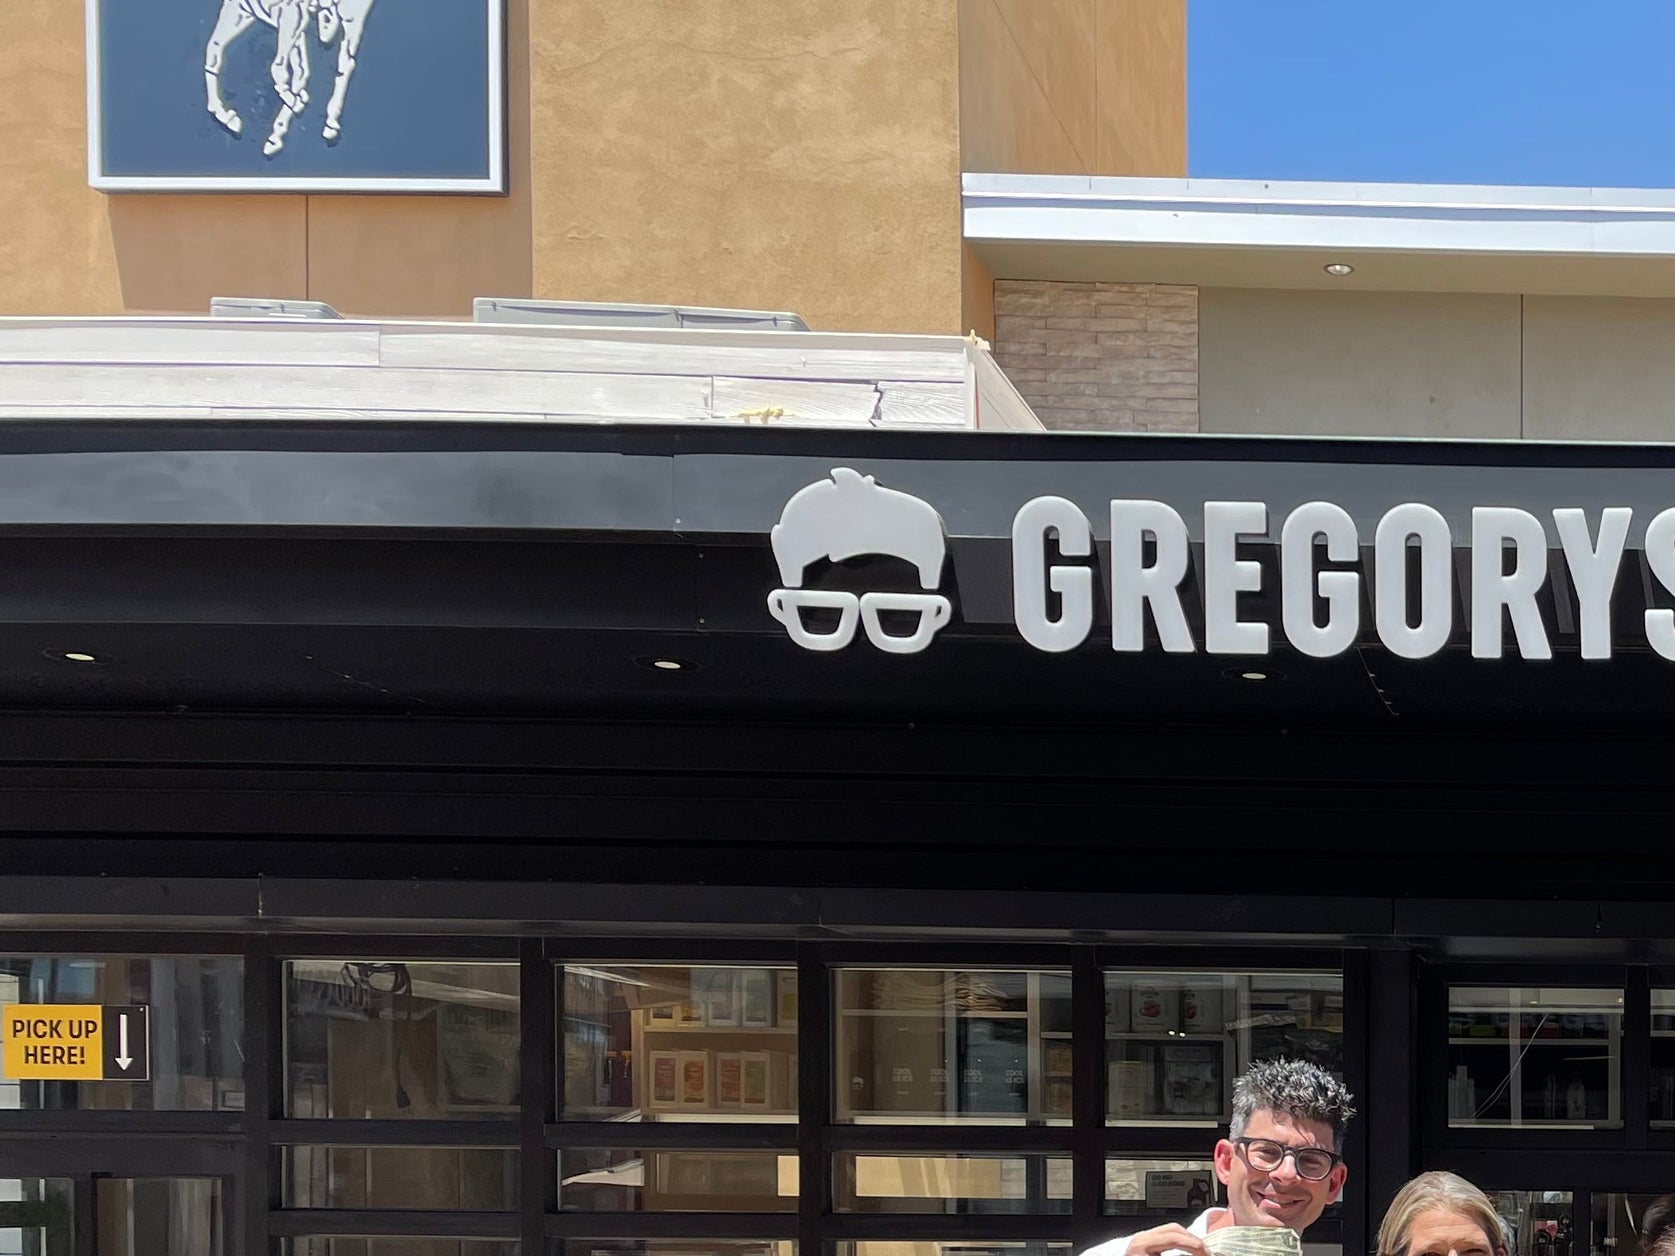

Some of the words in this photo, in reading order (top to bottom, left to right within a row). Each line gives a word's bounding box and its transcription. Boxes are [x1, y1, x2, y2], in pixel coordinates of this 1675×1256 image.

[12, 1019, 62, 1038] PICK
[69, 1020, 97, 1038] UP
[24, 1045, 85, 1064] HERE!
